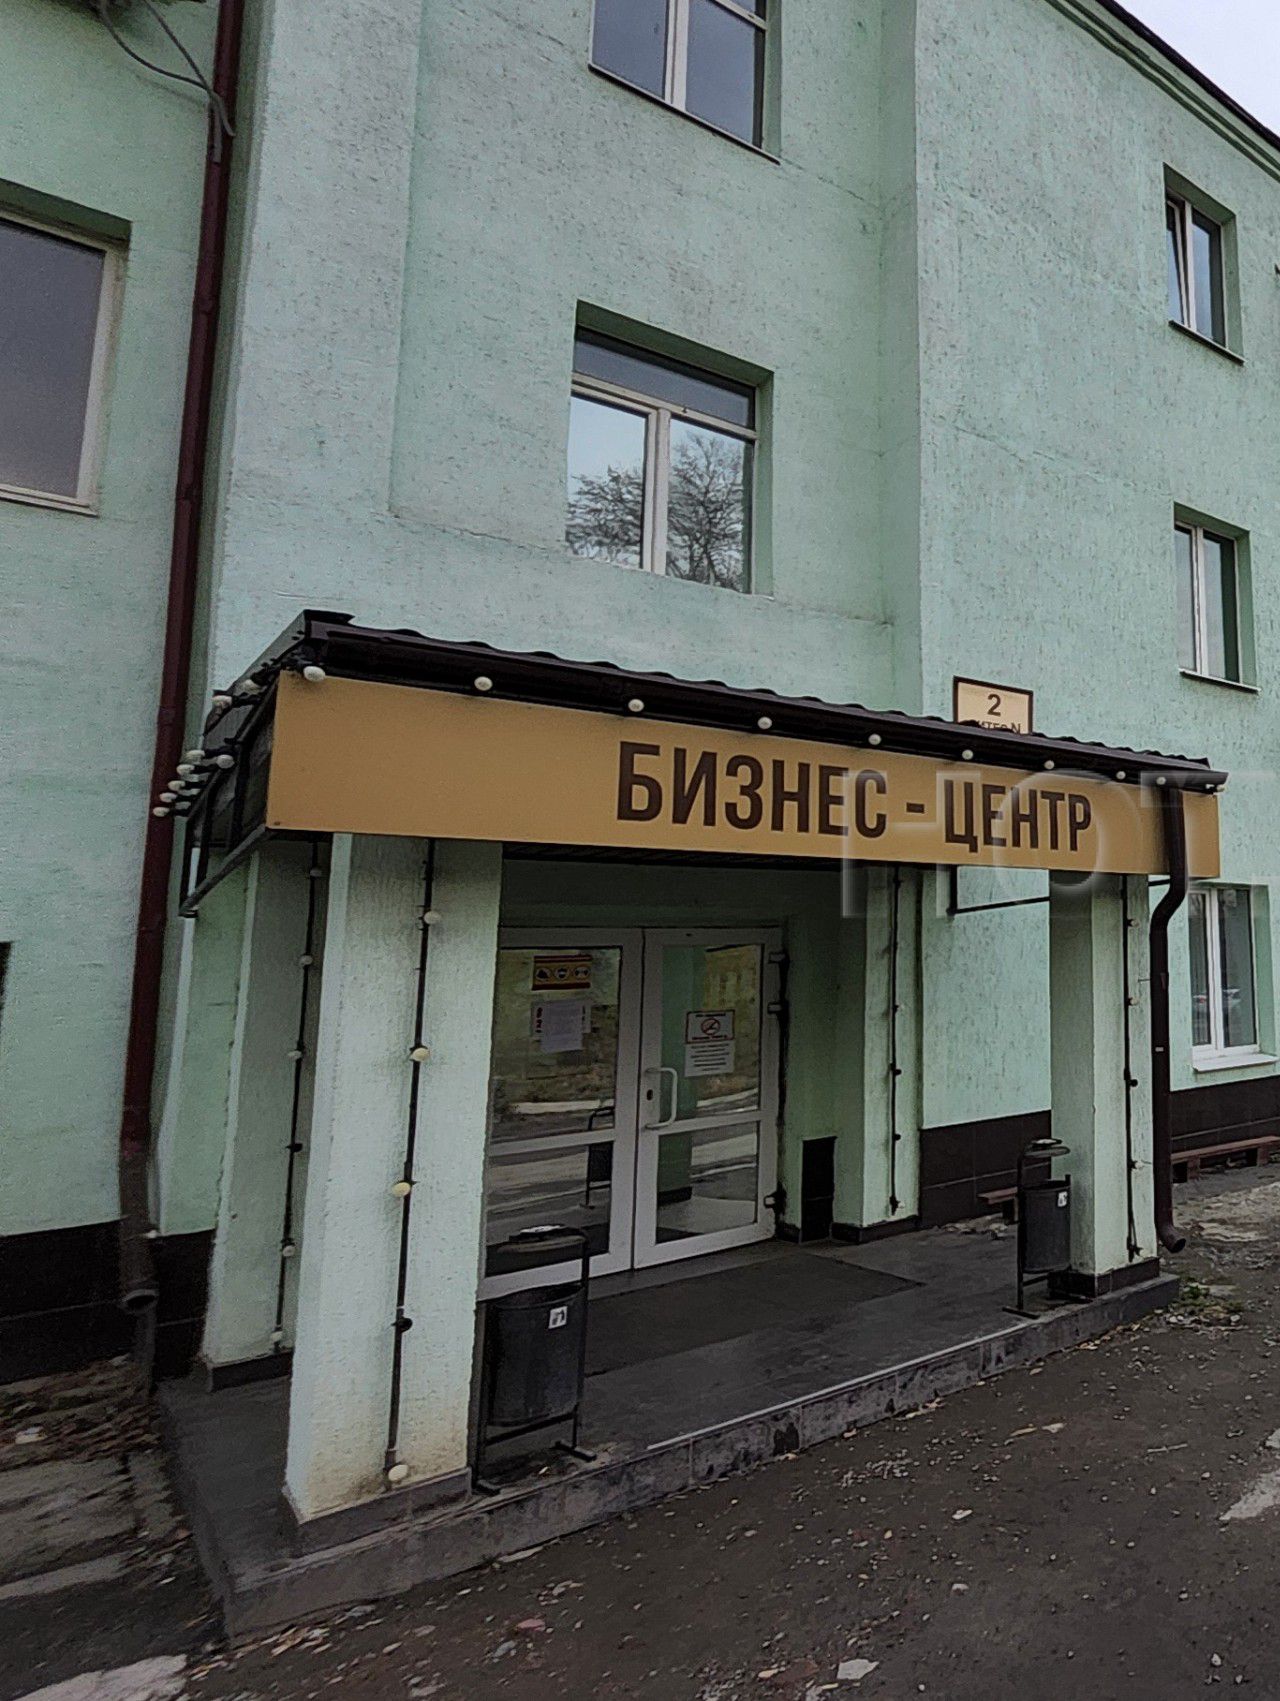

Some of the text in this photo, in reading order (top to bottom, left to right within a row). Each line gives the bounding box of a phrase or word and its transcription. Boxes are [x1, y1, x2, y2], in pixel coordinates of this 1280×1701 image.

[987, 693, 1002, 717] 2
[616, 740, 888, 839] БИЗНЕС
[943, 778, 1093, 854] ЦЕНТР
